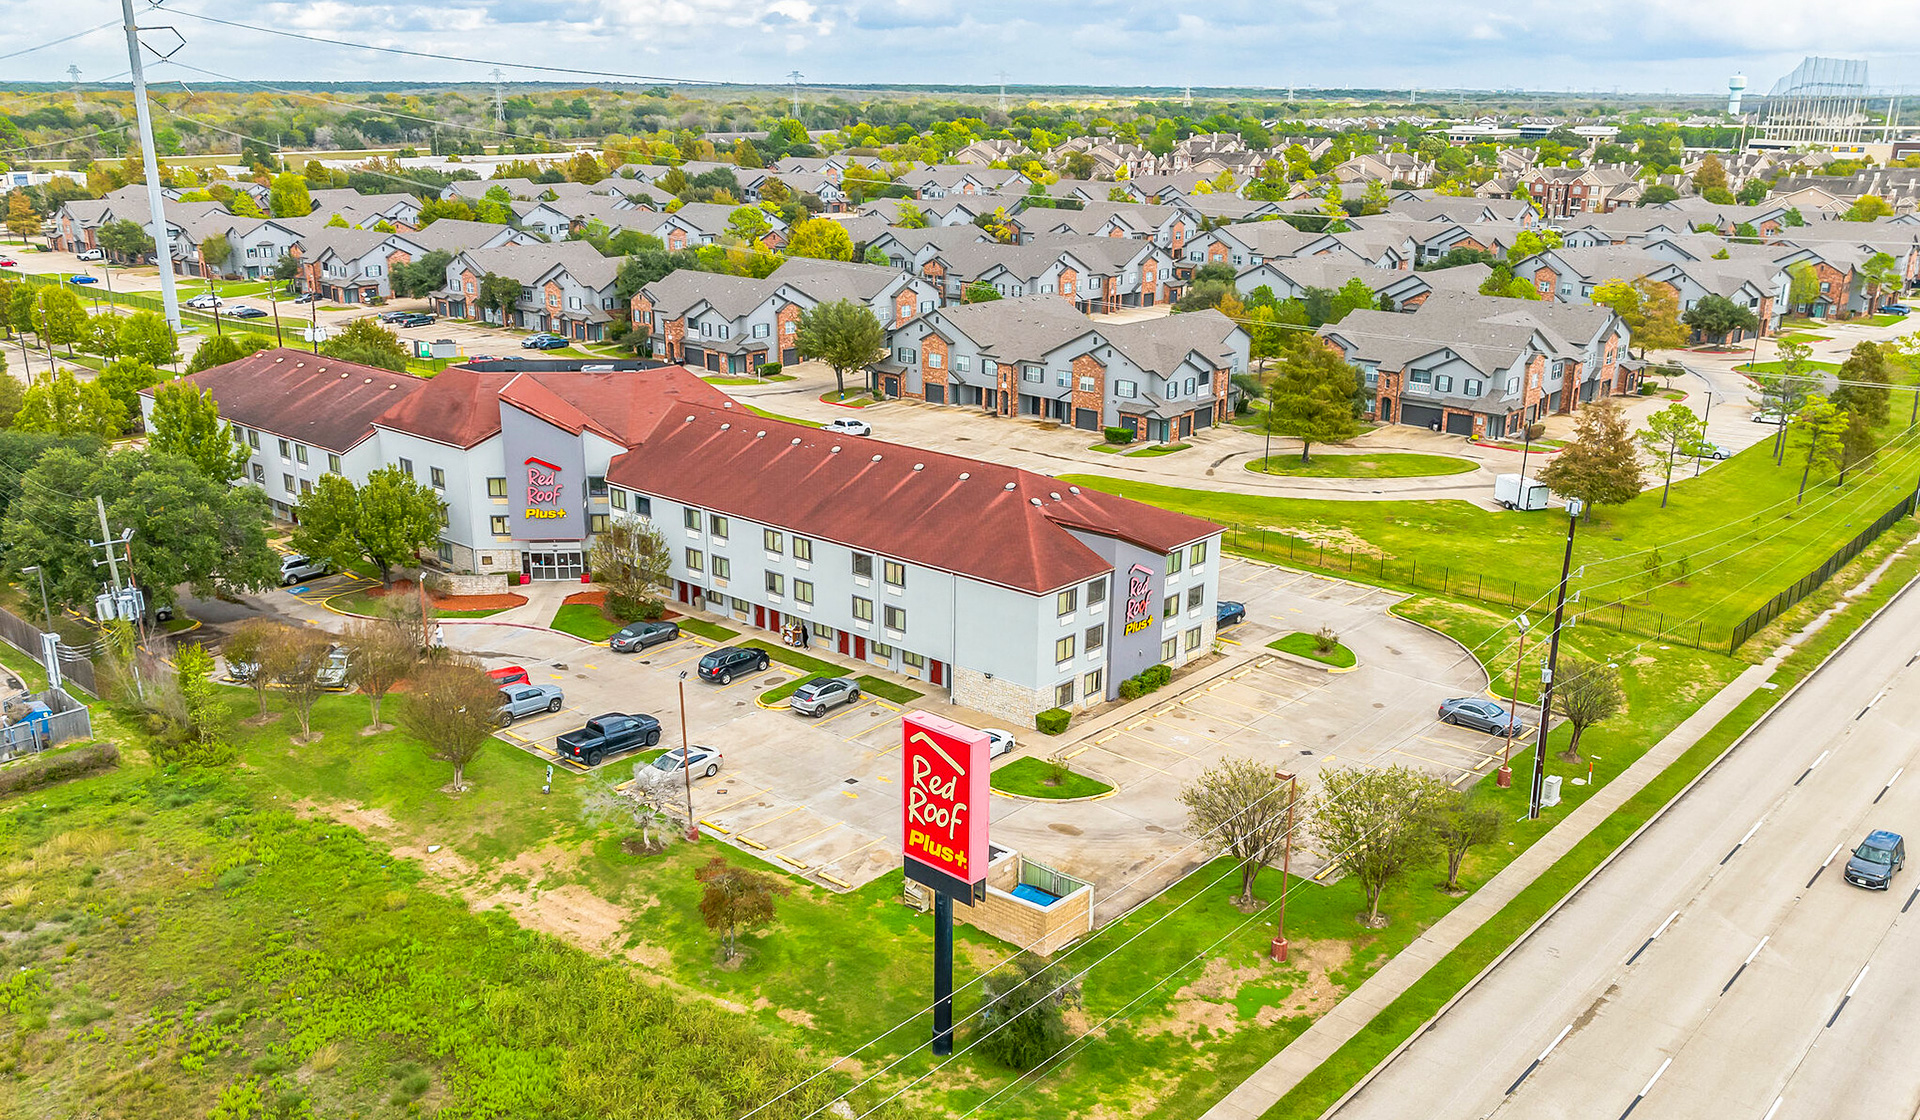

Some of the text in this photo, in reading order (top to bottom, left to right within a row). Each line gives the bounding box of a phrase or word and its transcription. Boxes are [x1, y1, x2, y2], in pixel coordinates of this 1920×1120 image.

[527, 468, 555, 487] Red
[527, 484, 563, 506] Roof
[525, 508, 566, 519] Plus+
[1129, 576, 1150, 597] Red
[1126, 590, 1153, 622] Roof
[1124, 615, 1154, 636] Plus+
[913, 755, 957, 801] Red
[908, 786, 967, 840] Roof
[908, 829, 967, 870] Plus+
